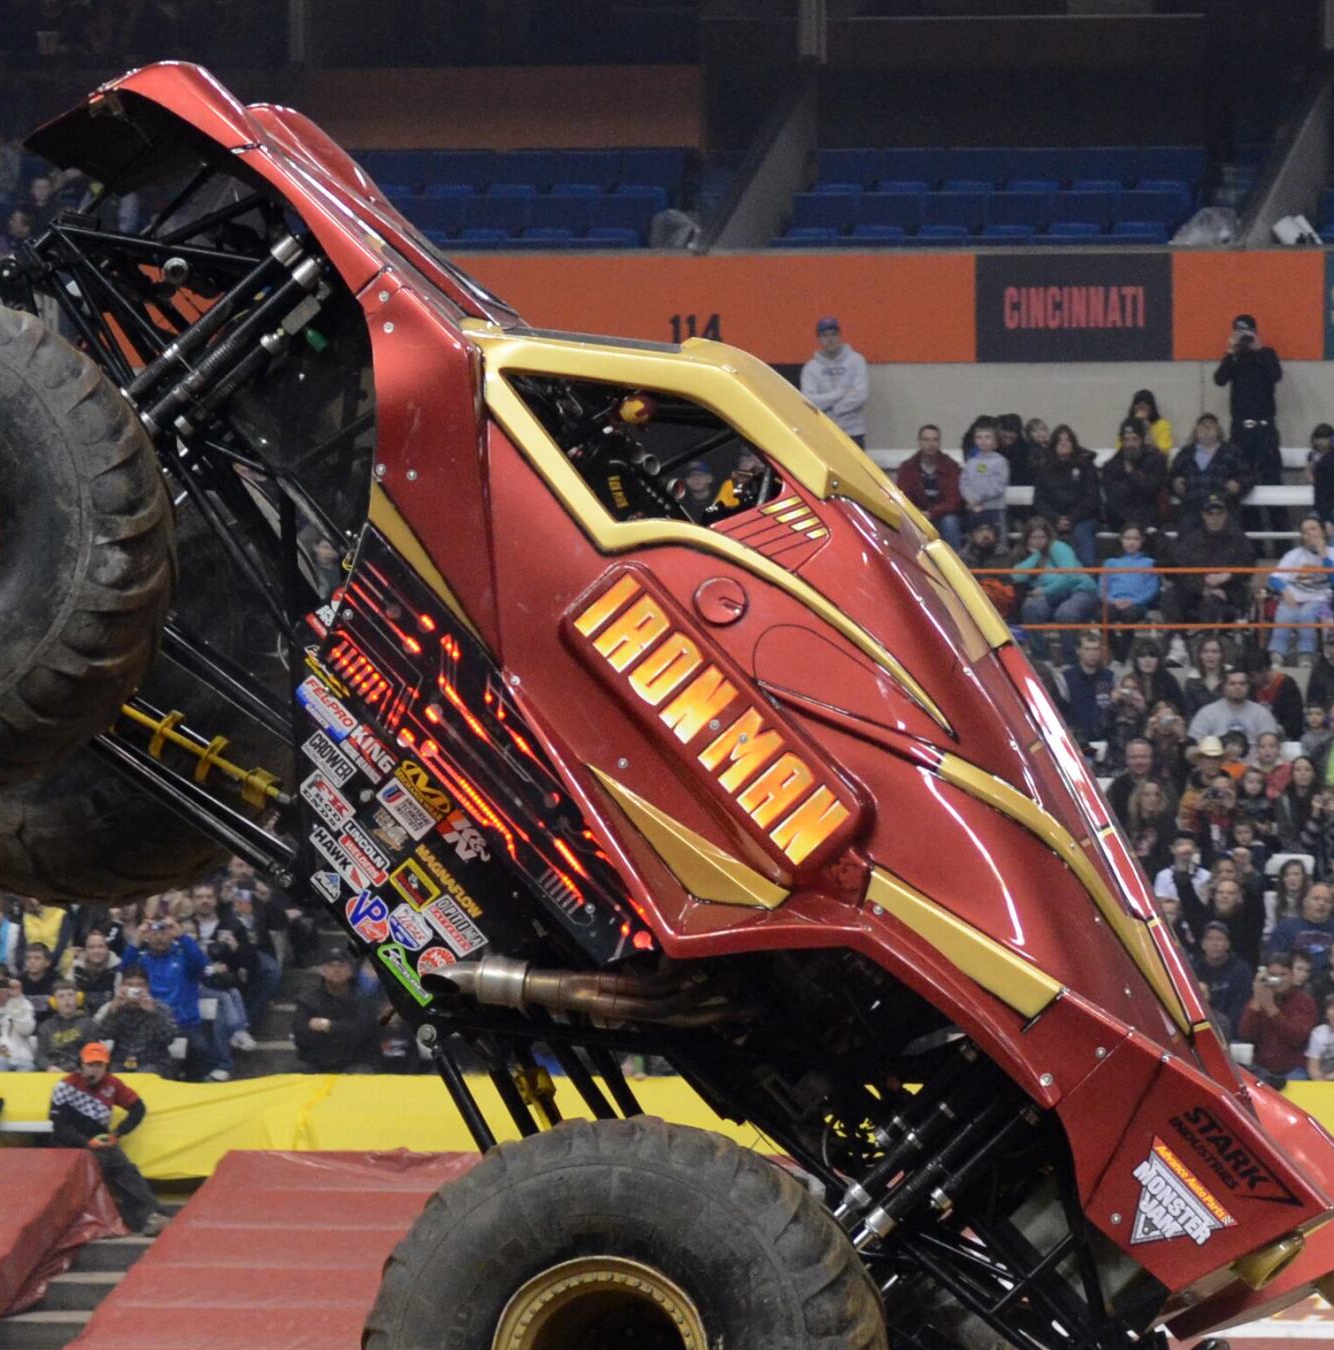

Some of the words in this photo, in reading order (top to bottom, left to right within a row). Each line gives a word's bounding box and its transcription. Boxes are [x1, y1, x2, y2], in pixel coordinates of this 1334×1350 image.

[670, 314, 720, 342] 114
[1003, 286, 1145, 330] CINCINNATI
[573, 574, 740, 745] IRON
[697, 707, 852, 866] MAN
[309, 733, 354, 780] CROWER
[350, 725, 396, 774] KING
[314, 830, 352, 871] HAWK
[345, 823, 385, 867] LINCOLN
[415, 844, 483, 919] MAGNAFLOW
[350, 892, 389, 926] VP
[437, 898, 485, 946] OPTIMA
[1184, 1106, 1271, 1189] STARK
[1133, 1161, 1211, 1245] MONSTER
[1139, 1192, 1182, 1239] JAM
